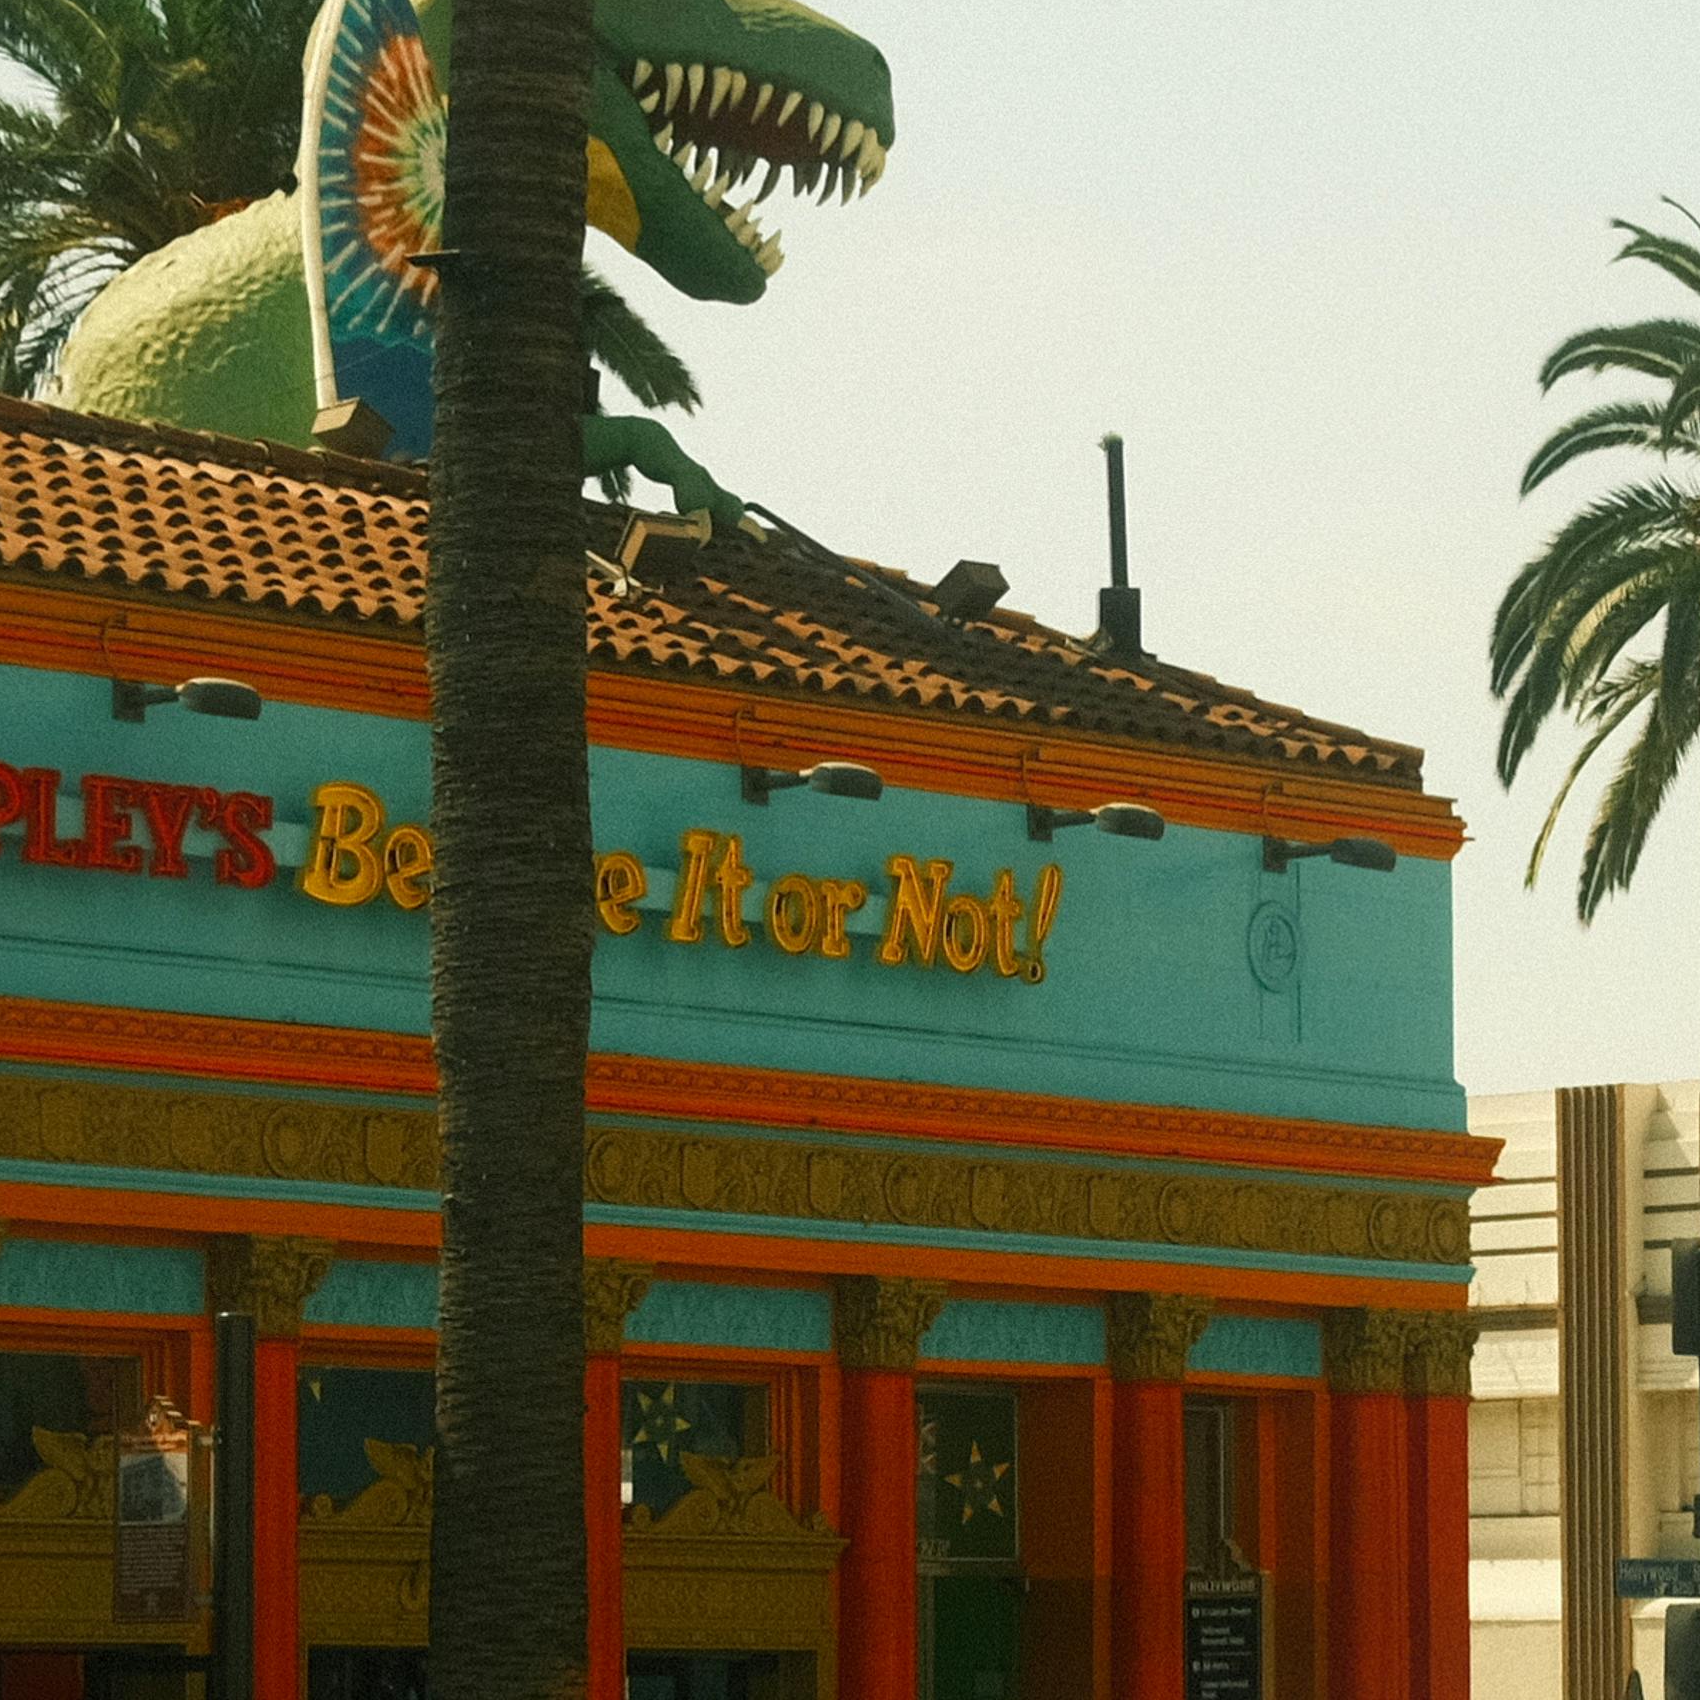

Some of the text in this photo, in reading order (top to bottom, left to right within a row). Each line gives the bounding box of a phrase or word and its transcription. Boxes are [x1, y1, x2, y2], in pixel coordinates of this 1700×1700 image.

[670, 830, 752, 946] It
[772, 874, 866, 957] or
[882, 855, 1062, 983] Not!
